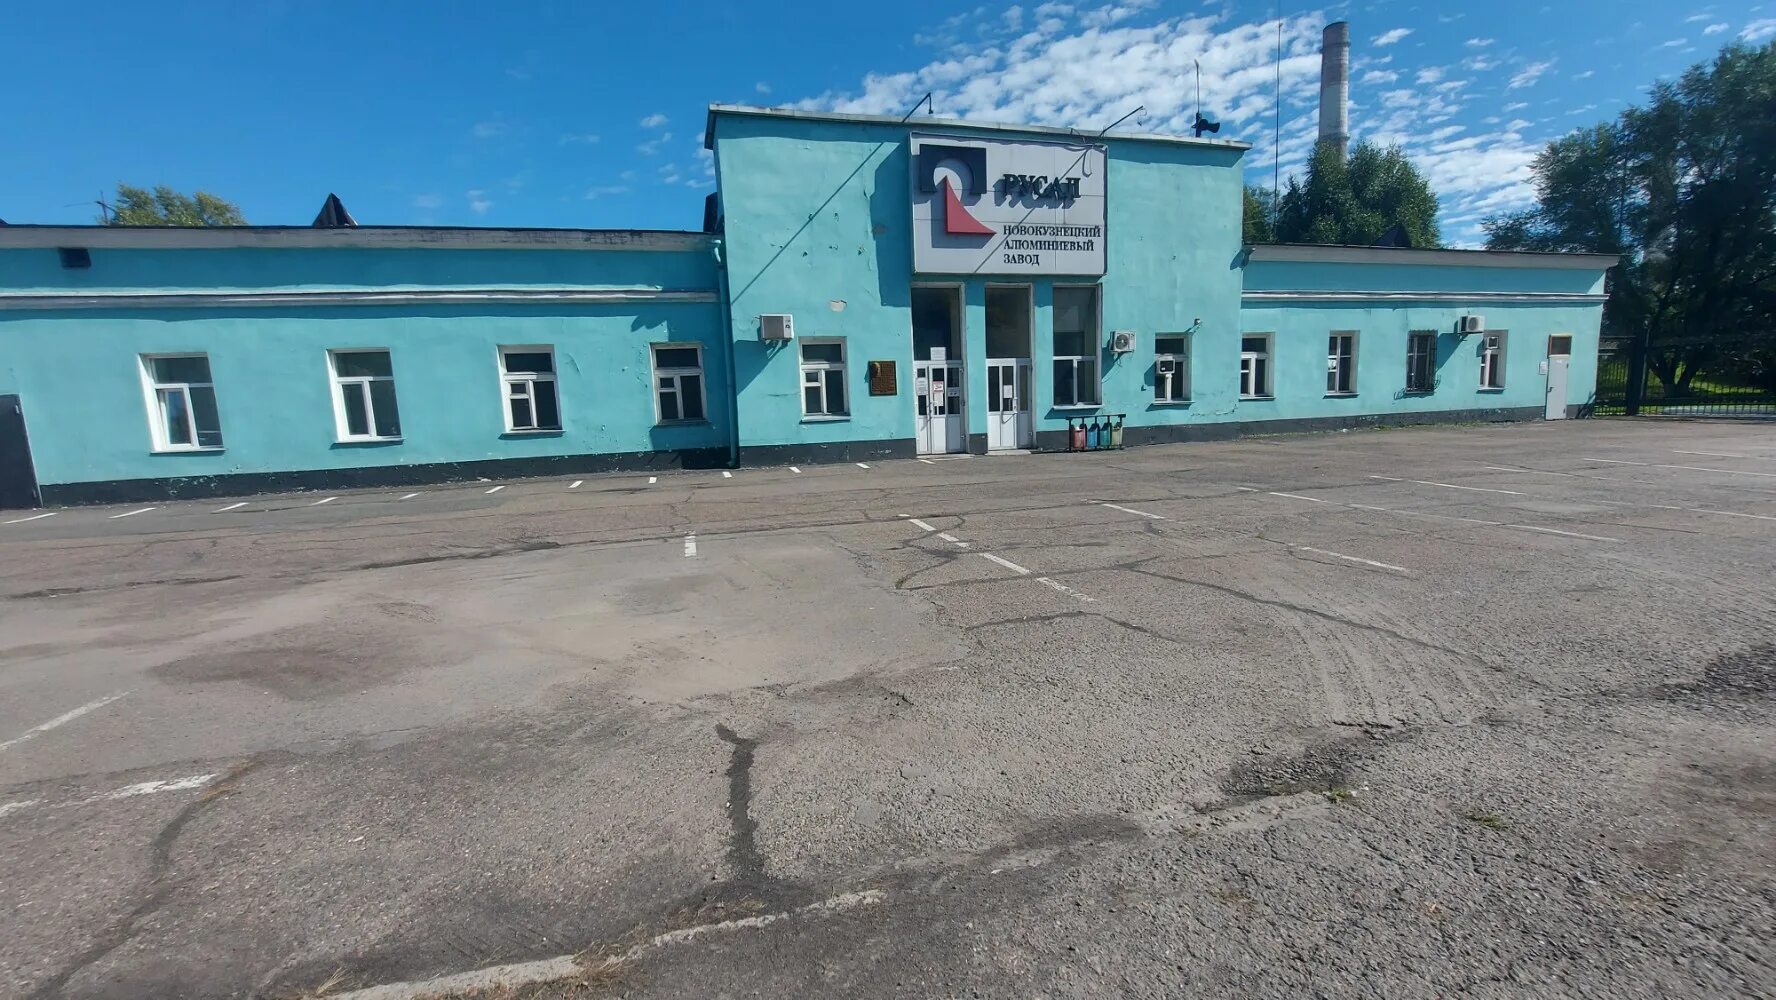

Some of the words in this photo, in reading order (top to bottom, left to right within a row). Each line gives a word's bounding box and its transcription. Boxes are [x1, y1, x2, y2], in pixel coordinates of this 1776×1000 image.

[1003, 173, 1081, 199] РУСАЛ
[1003, 225, 1101, 238] НОВОКУЗНЕЦКИЙ
[1003, 239, 1095, 251] АЛЮМИНИЕВЫЙ
[1003, 254, 1040, 266] ЗАВОД
